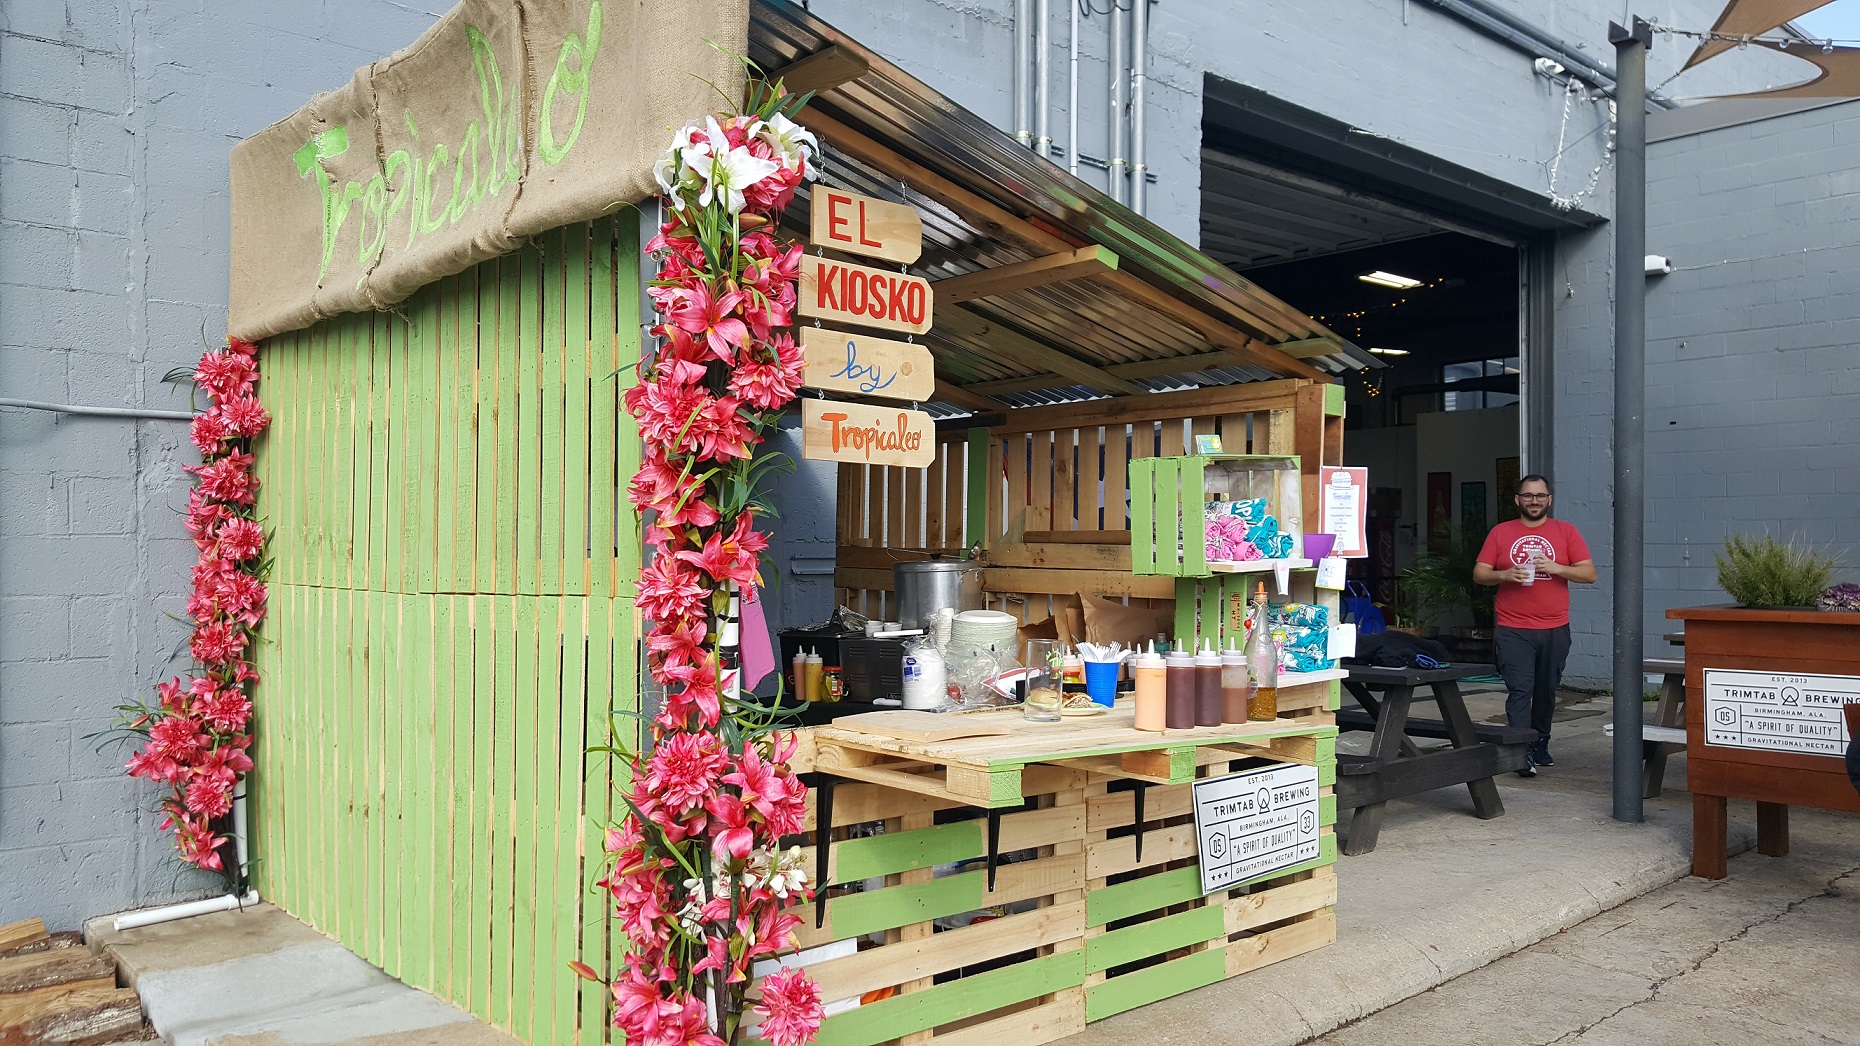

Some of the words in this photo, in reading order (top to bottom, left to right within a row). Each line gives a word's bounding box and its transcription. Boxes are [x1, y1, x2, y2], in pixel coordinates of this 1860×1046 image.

[828, 193, 882, 248] EL
[817, 263, 926, 325] KIOSKO
[830, 341, 897, 393] by
[820, 412, 922, 460] Tropicaleo
[1724, 689, 1776, 700] TRIMTAB
[1758, 721, 1782, 732] SPIRIT
[1785, 723, 1794, 732] OF
[1748, 736, 1802, 747] GRAVITATIONAL
[1806, 742, 1835, 750] NECTAR
[1248, 776, 1260, 785] EST.
[1262, 774, 1274, 782] 2013
[1214, 800, 1254, 817] TRIMTAB
[1274, 787, 1310, 804] BREWING
[1303, 816, 1311, 829] 33
[1213, 838, 1222, 853] 05
[1242, 839, 1260, 854] SPIRIT
[1262, 837, 1270, 849] OF
[1236, 858, 1274, 874] GRAVITATIONAL
[1274, 852, 1294, 863] NECTAR
